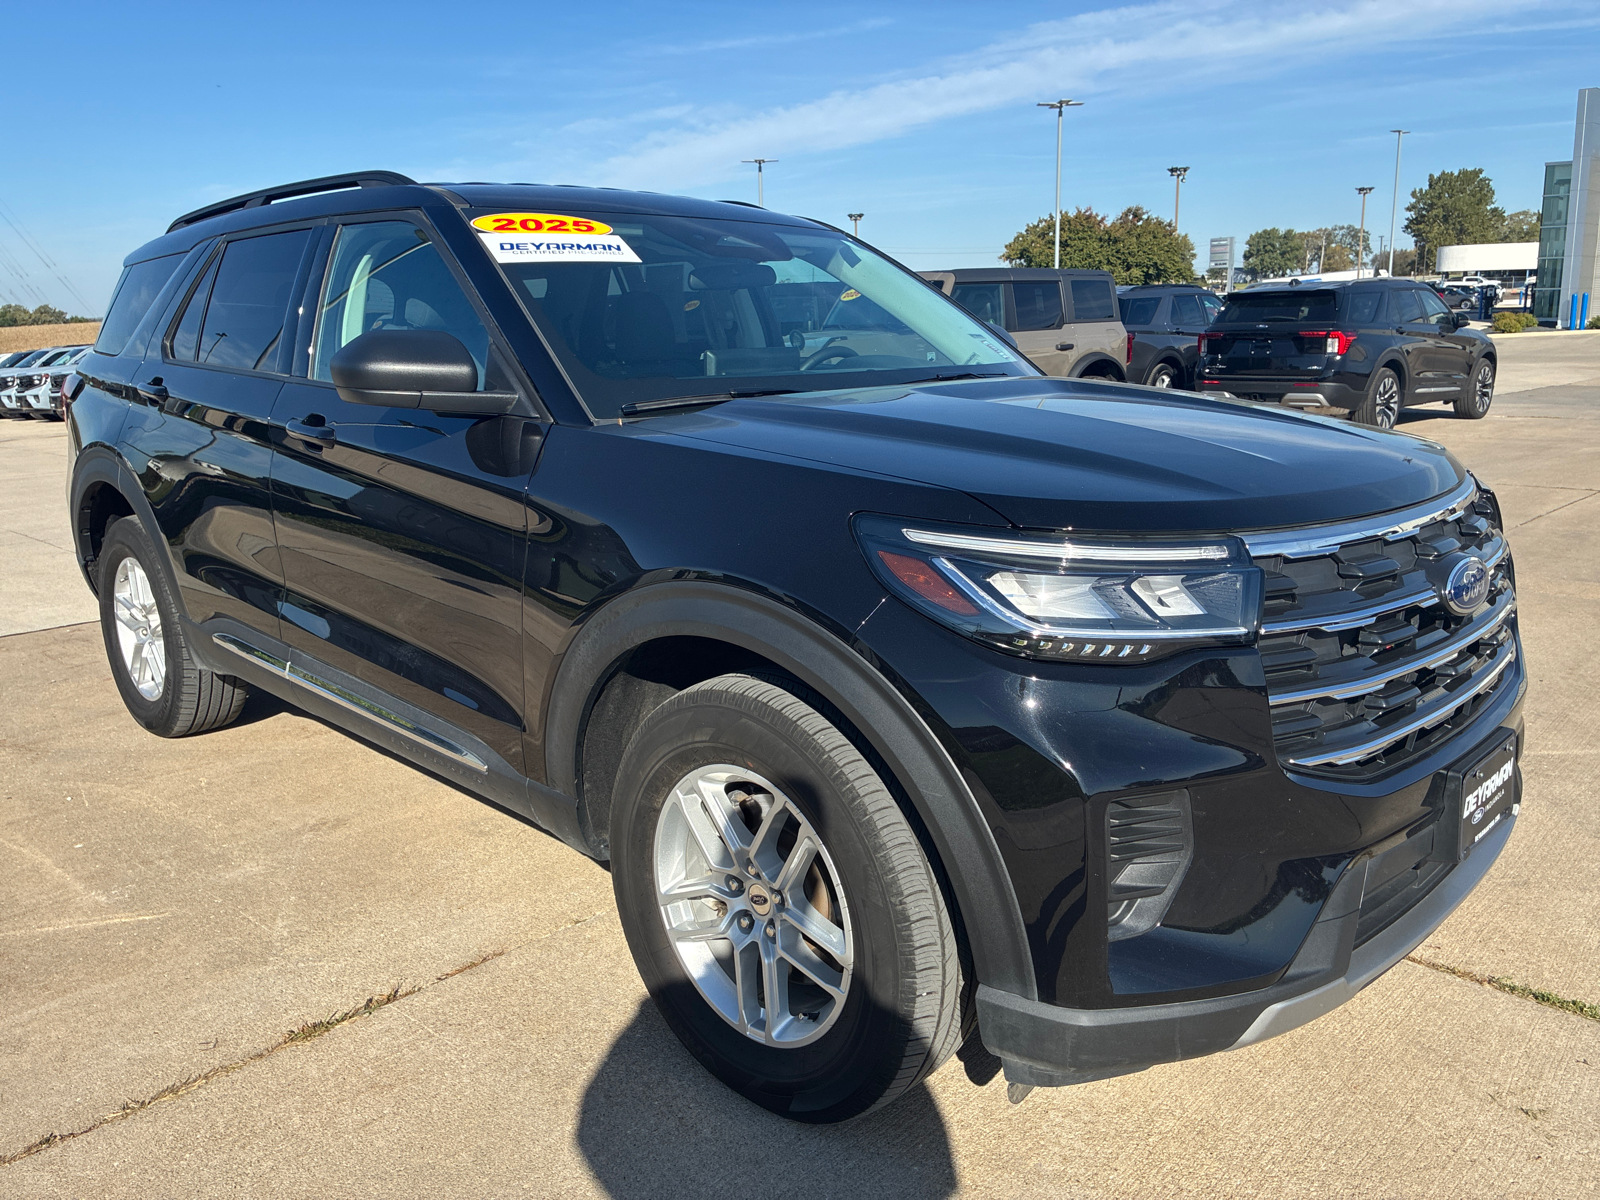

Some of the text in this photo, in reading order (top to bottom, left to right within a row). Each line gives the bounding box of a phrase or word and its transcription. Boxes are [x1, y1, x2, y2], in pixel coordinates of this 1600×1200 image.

[492, 218, 597, 233] 2025
[499, 242, 622, 252] DEYARMAN
[1463, 757, 1514, 819] DEYARMAN
